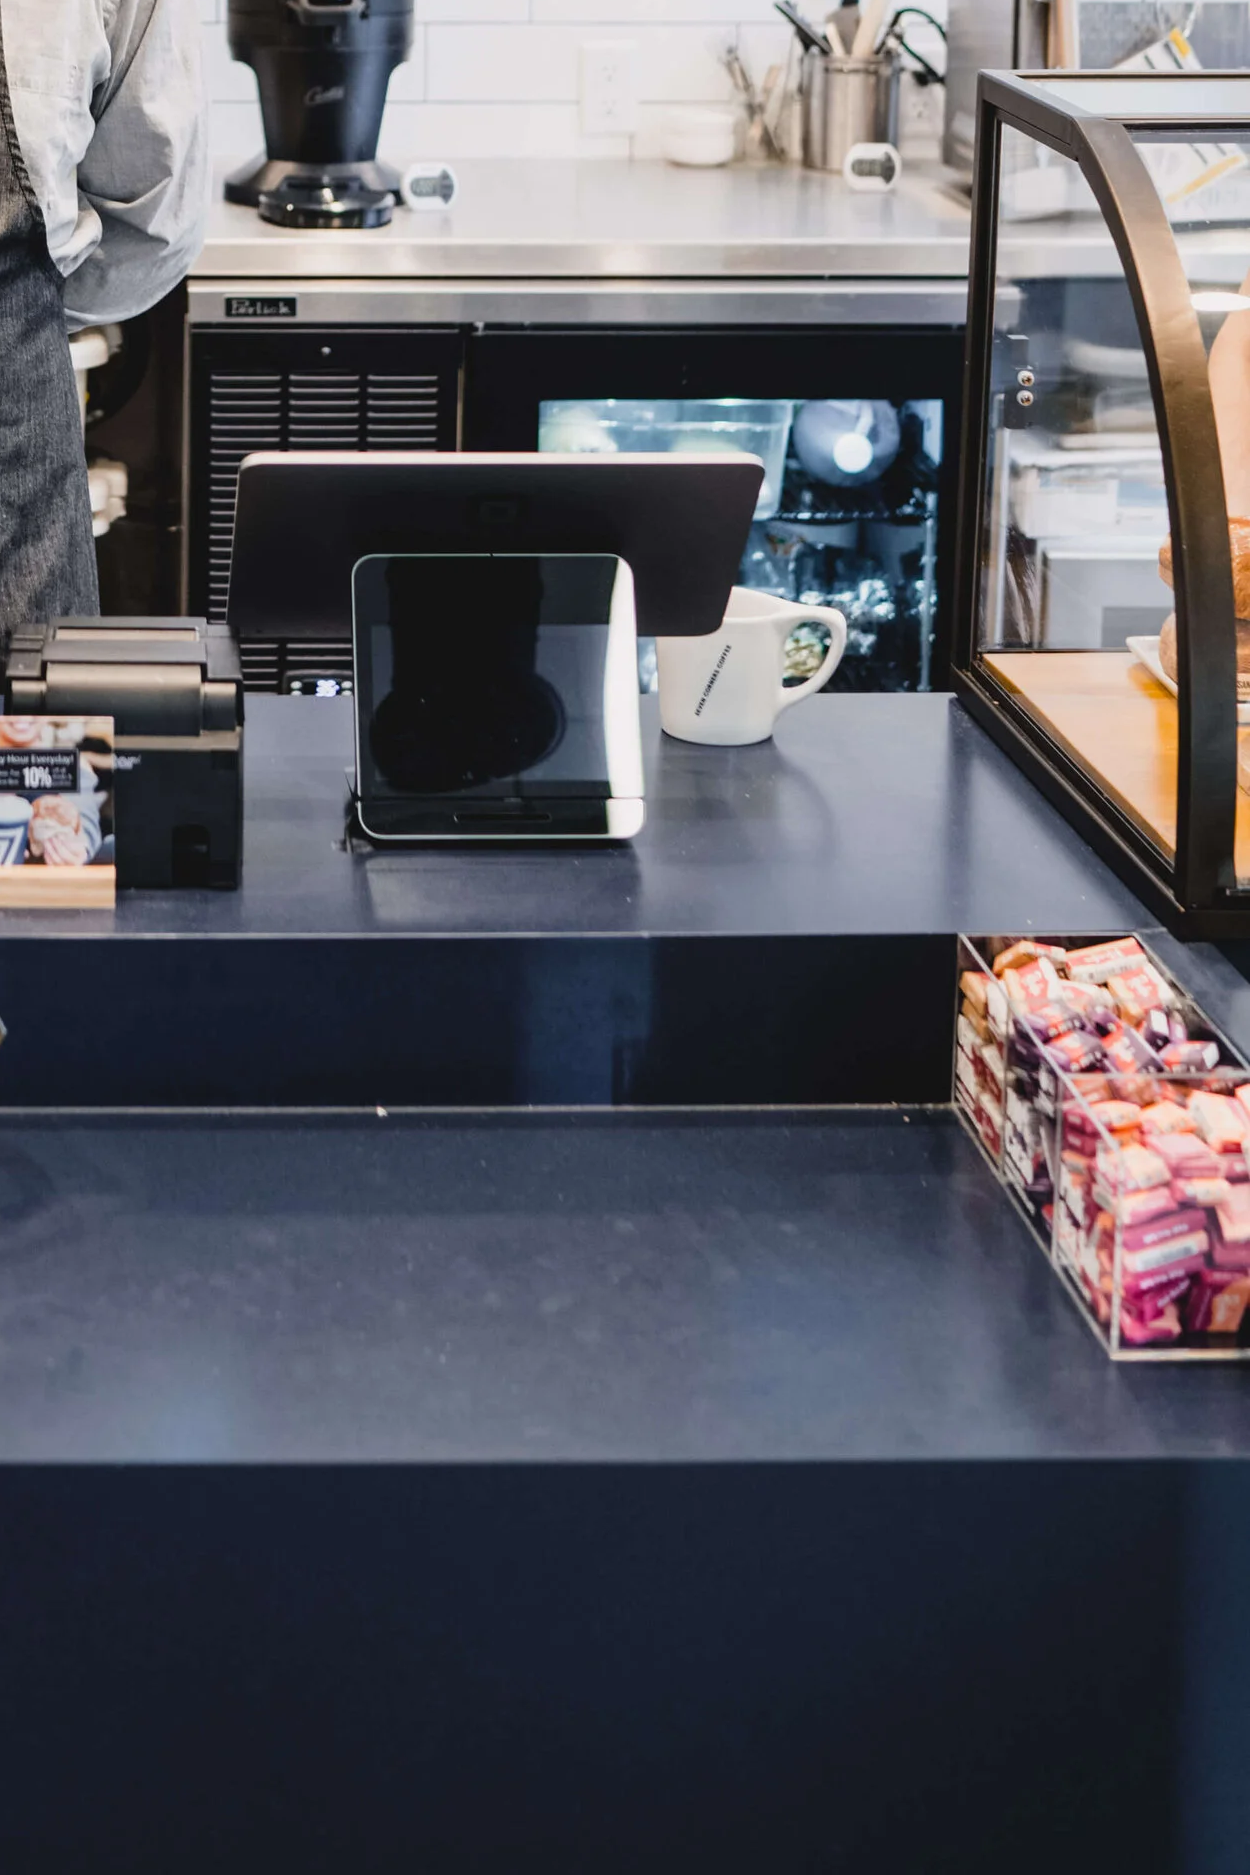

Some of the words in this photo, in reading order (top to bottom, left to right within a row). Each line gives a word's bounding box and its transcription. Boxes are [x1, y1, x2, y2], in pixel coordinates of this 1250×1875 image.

[703, 669, 720, 697] CORNERS
[7, 754, 29, 764] Hour
[31, 753, 74, 766] Everyday!
[22, 766, 52, 788] 10%
